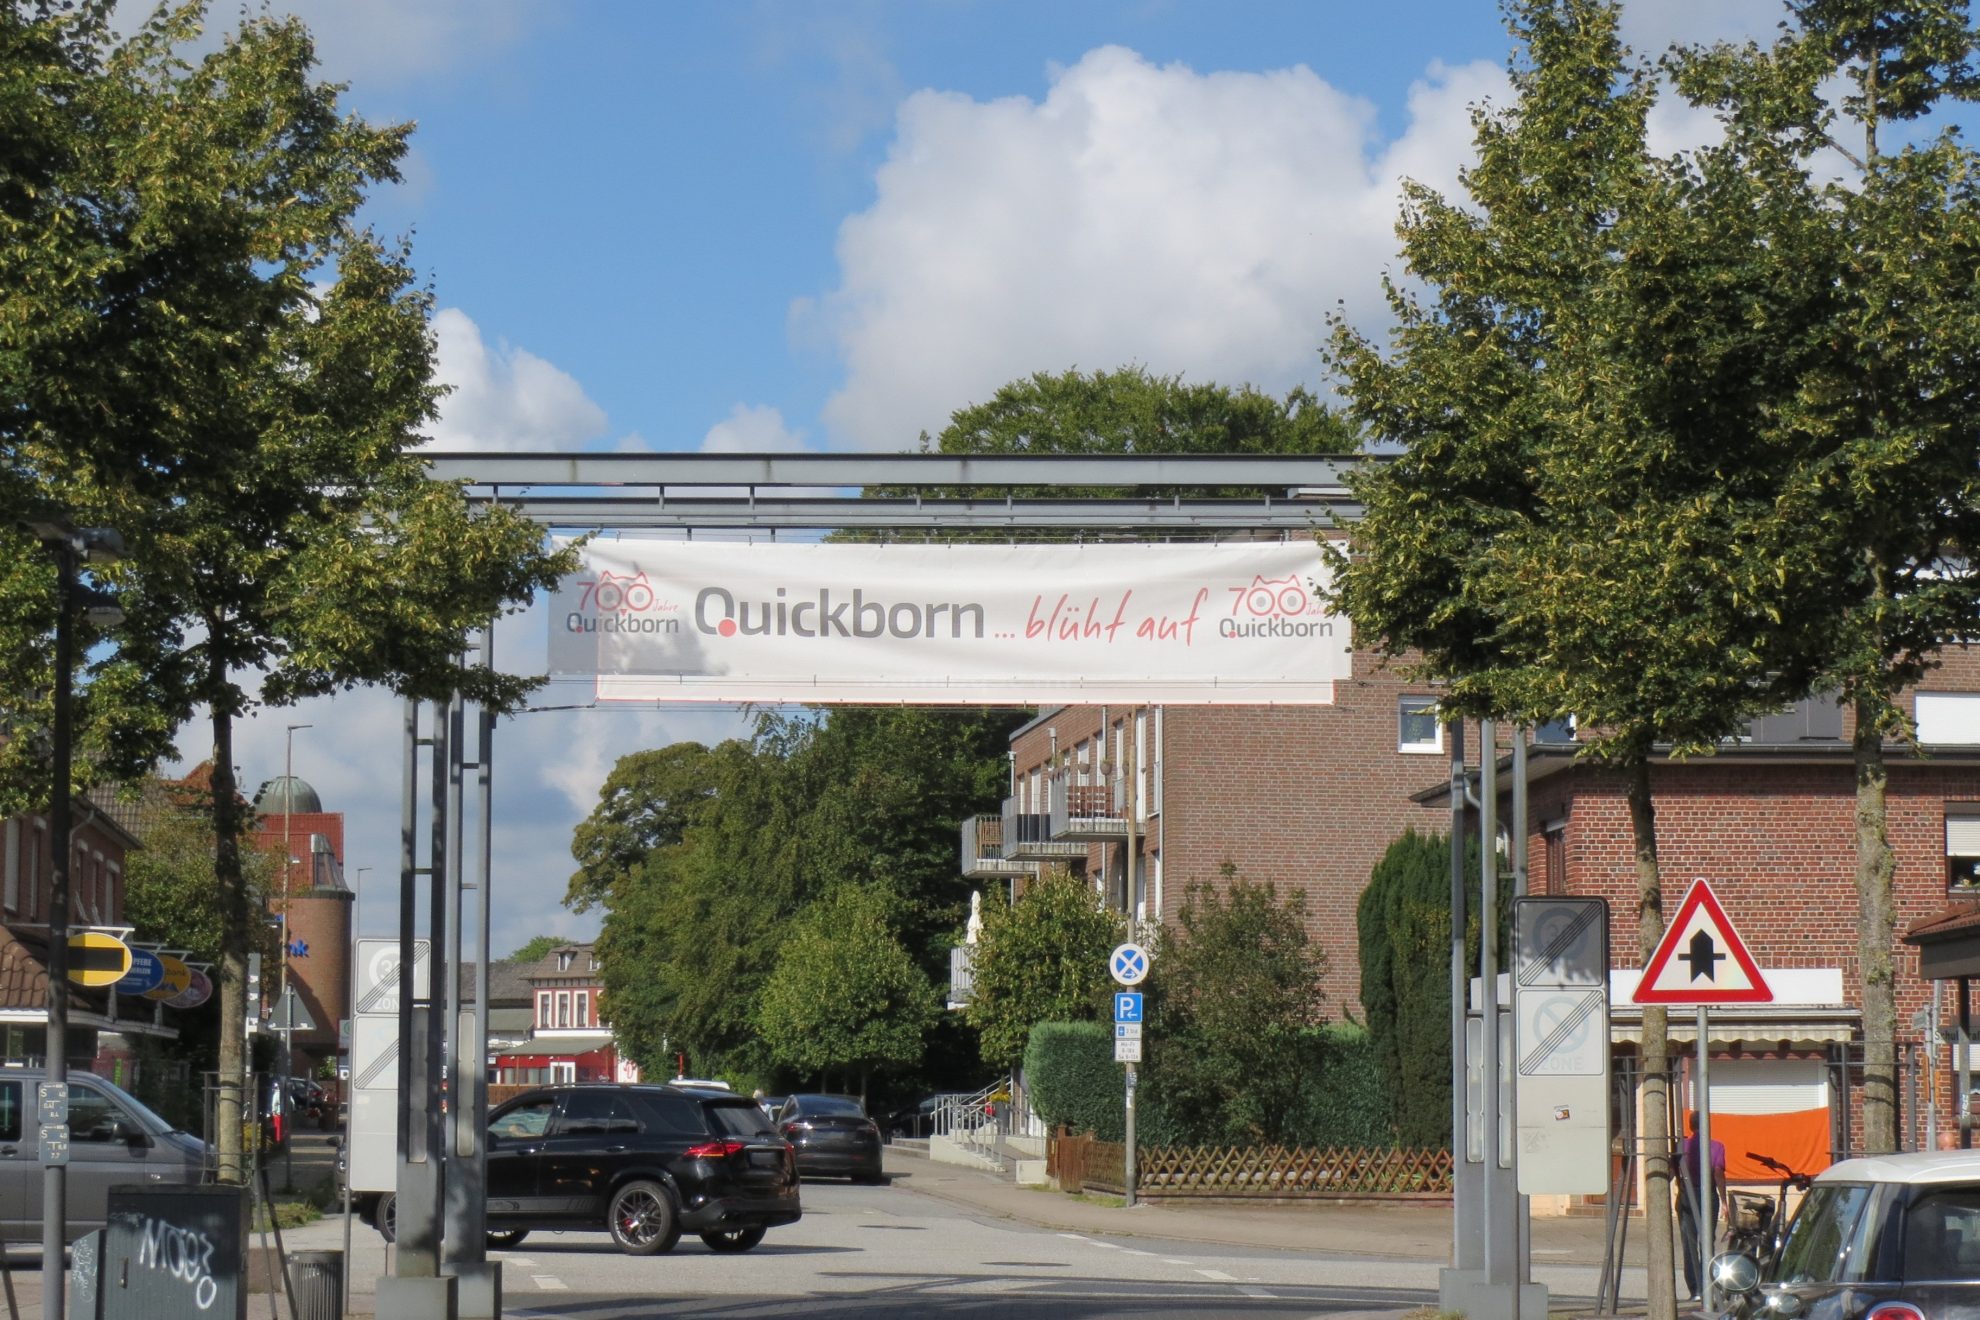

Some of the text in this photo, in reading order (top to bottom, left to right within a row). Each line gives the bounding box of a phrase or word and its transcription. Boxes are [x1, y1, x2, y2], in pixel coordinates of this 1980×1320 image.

[576, 582, 679, 613] 700 Jahre
[1228, 586, 1307, 617] 700
[567, 612, 679, 633] Quickborn
[695, 586, 984, 639] Quickborn
[1136, 587, 1209, 647] auf
[1219, 617, 1333, 639] Quickborn
[1120, 996, 1135, 1019] P
